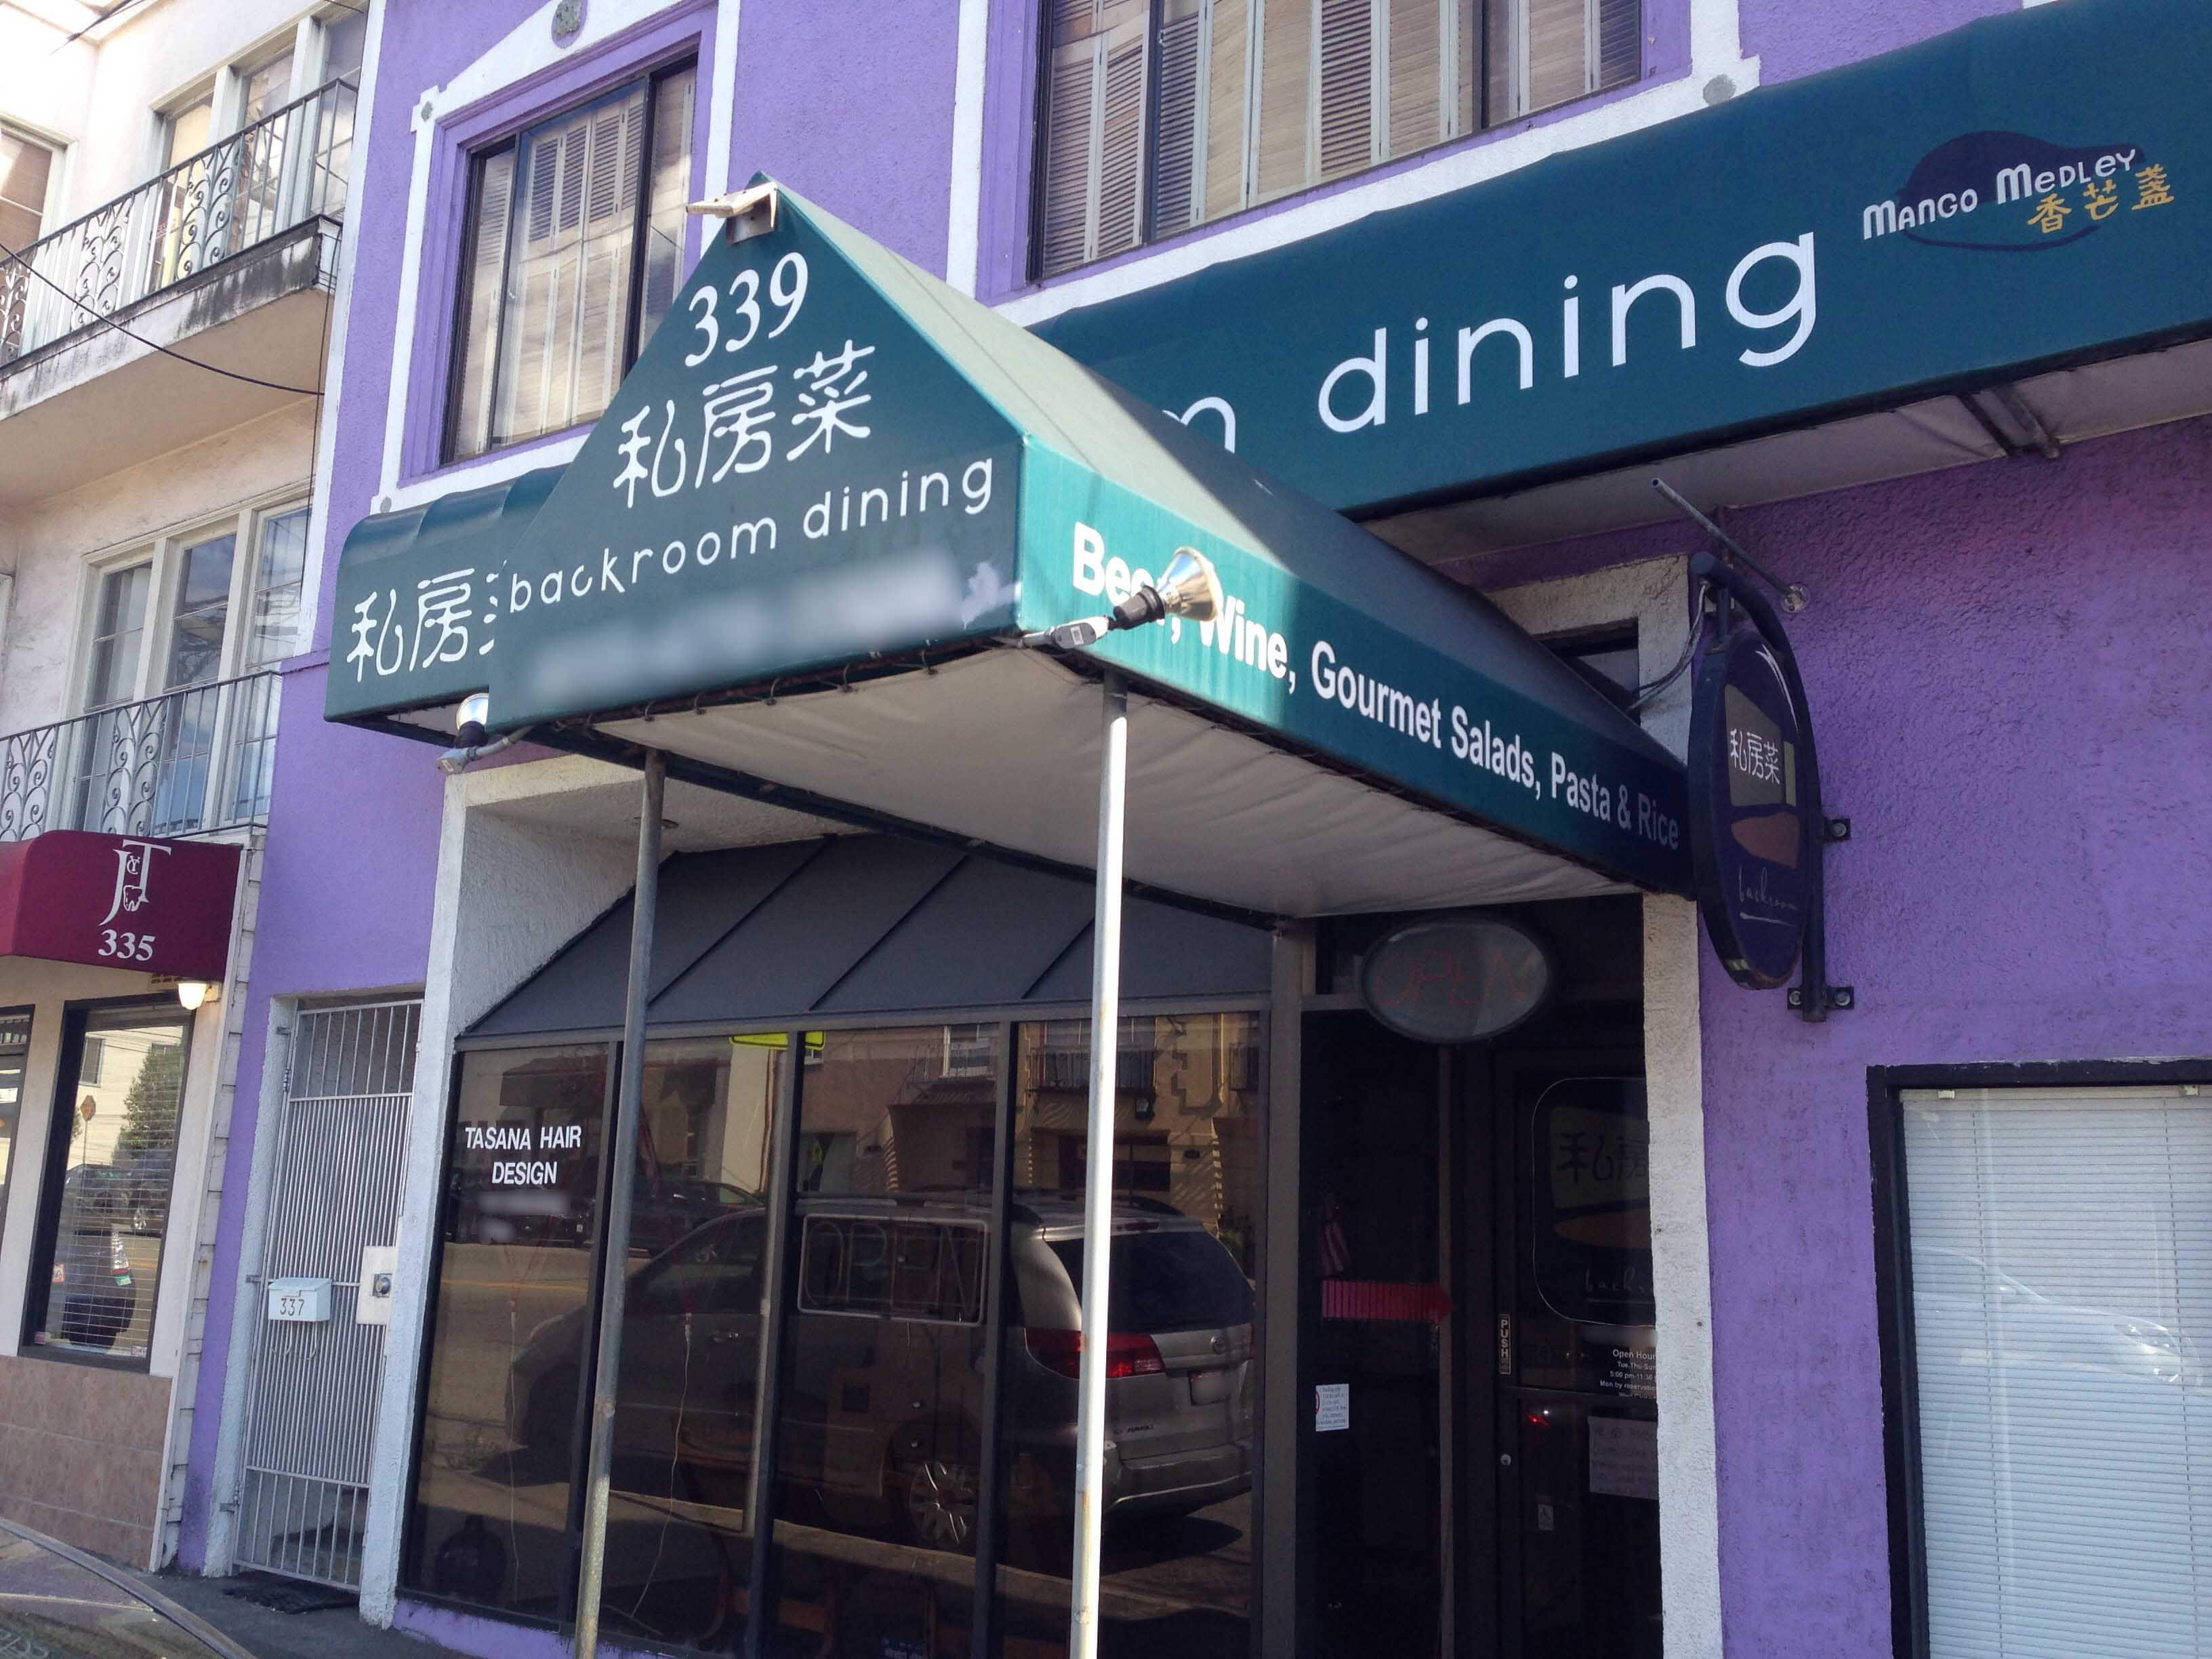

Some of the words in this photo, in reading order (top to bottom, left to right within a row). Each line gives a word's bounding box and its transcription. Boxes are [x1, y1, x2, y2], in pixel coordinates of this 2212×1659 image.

[685, 252, 808, 367] 339
[1318, 232, 1816, 432] dining
[613, 340, 876, 508] 私房菜
[509, 517, 776, 614] backroom
[802, 457, 994, 538] dining
[346, 559, 507, 682] 私房
[1311, 641, 1441, 748] Gourmet
[1451, 705, 1541, 800] Salads,
[1551, 752, 1611, 821] Pasta
[1618, 784, 1631, 829] &
[1638, 792, 1679, 851] Rice
[1729, 728, 1780, 785] 私房菜
[98, 929, 156, 961] 335
[465, 1127, 531, 1150] TASANA
[540, 1125, 581, 1149] HAIR
[492, 1161, 557, 1185] DESIGN
[280, 1298, 304, 1316] 337
[1500, 1319, 1509, 1357] PUSH
[1612, 1349, 1635, 1359] Open
